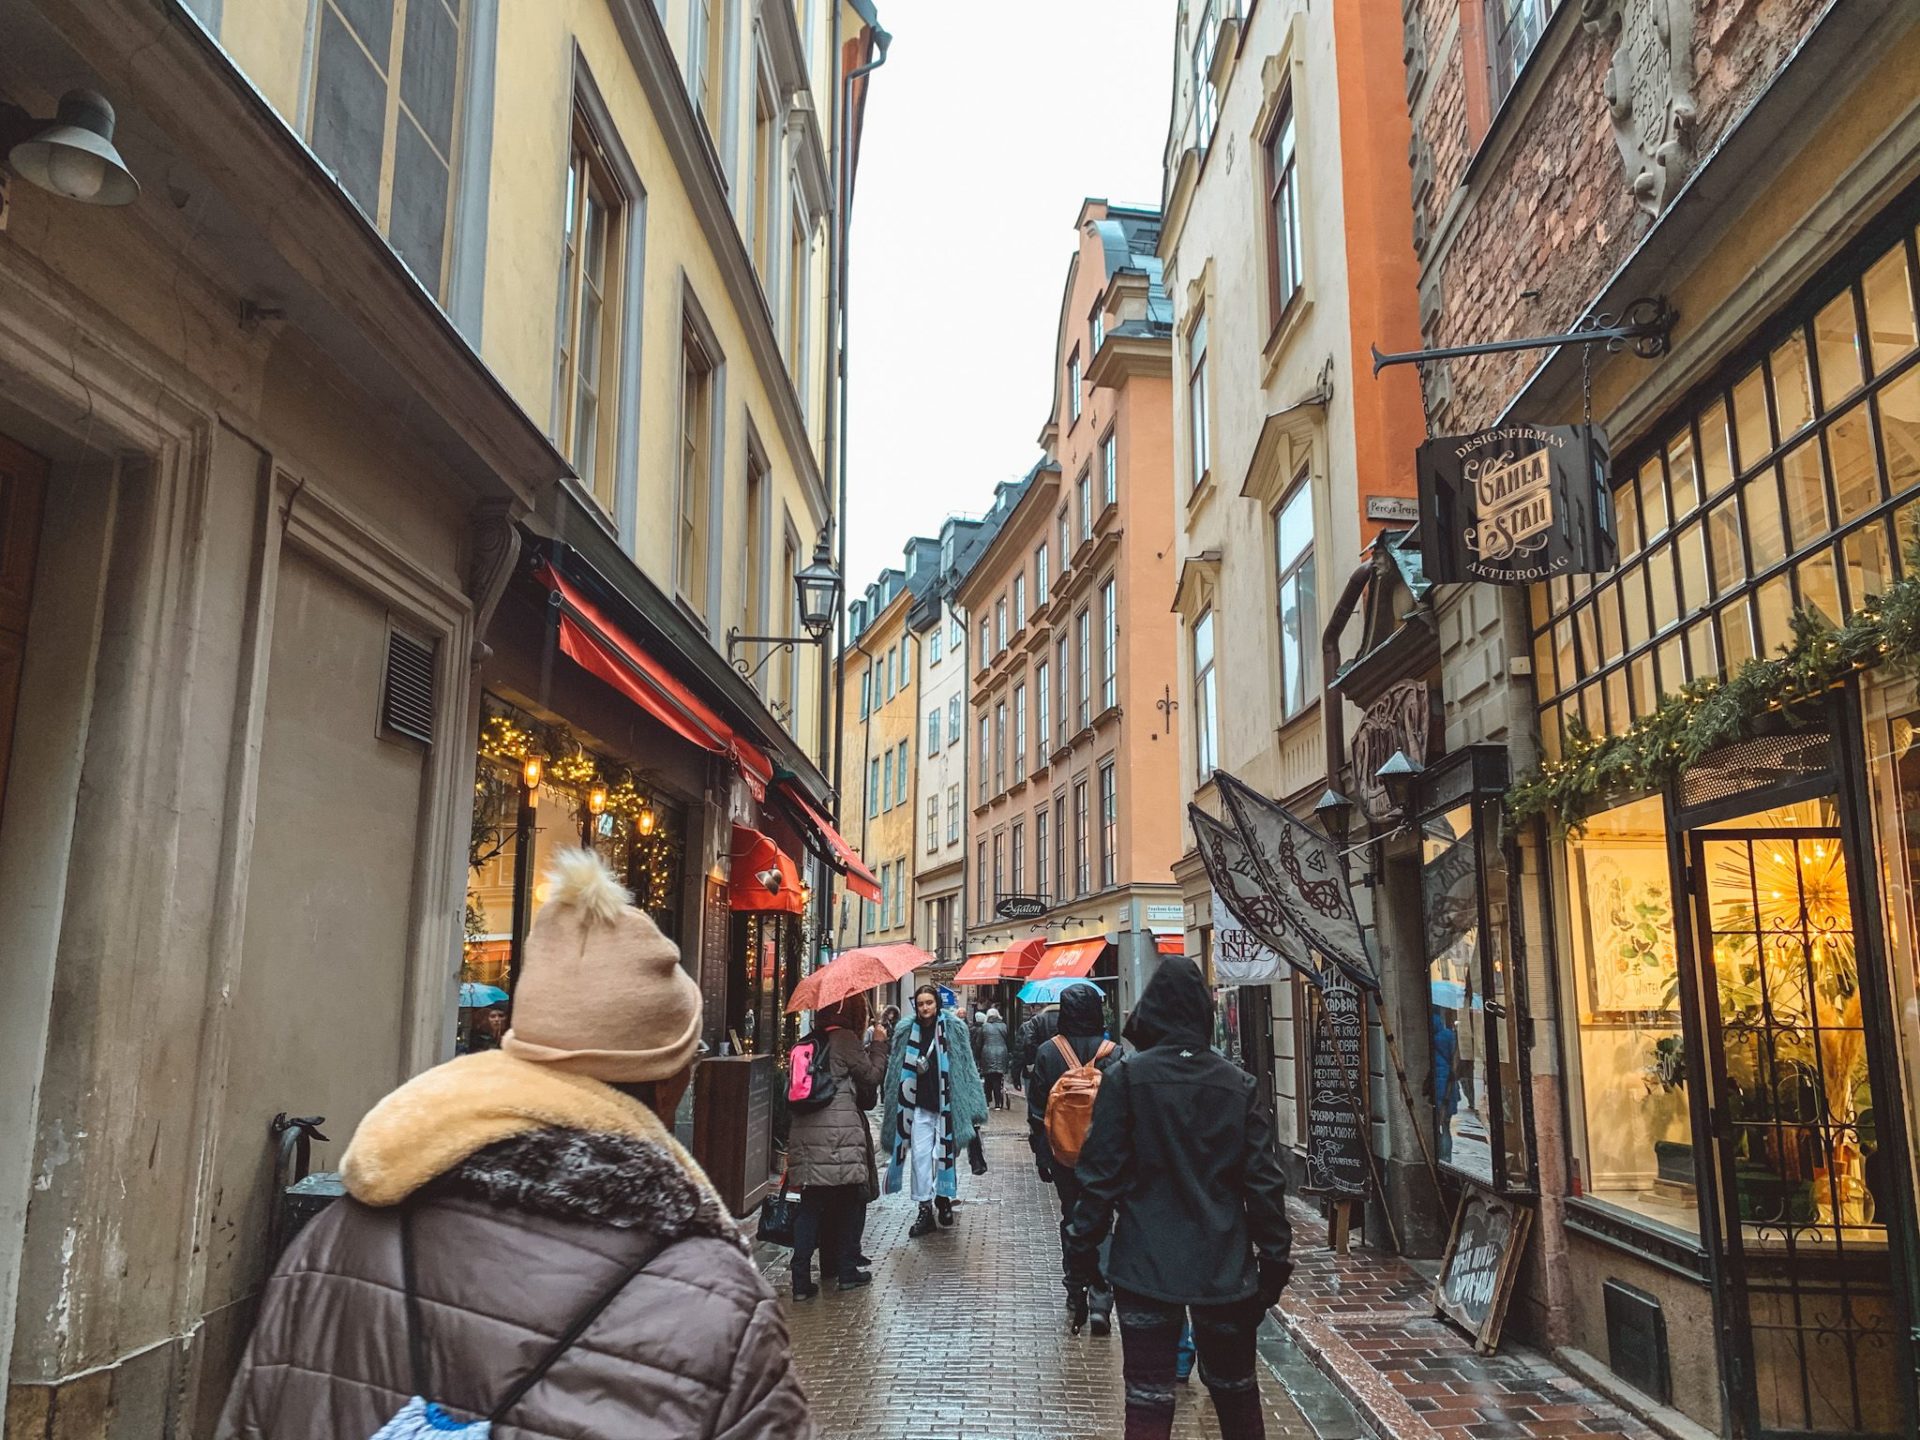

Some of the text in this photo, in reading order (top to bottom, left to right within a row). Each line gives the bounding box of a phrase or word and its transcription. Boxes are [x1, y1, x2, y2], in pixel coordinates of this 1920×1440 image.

[1455, 427, 1567, 459] DESIGNFIRMAN
[1470, 451, 1545, 507] GAMLA
[1478, 497, 1546, 559] STAN
[1466, 555, 1569, 581] AKTIEBOLAG
[1000, 900, 1042, 917] Agaton
